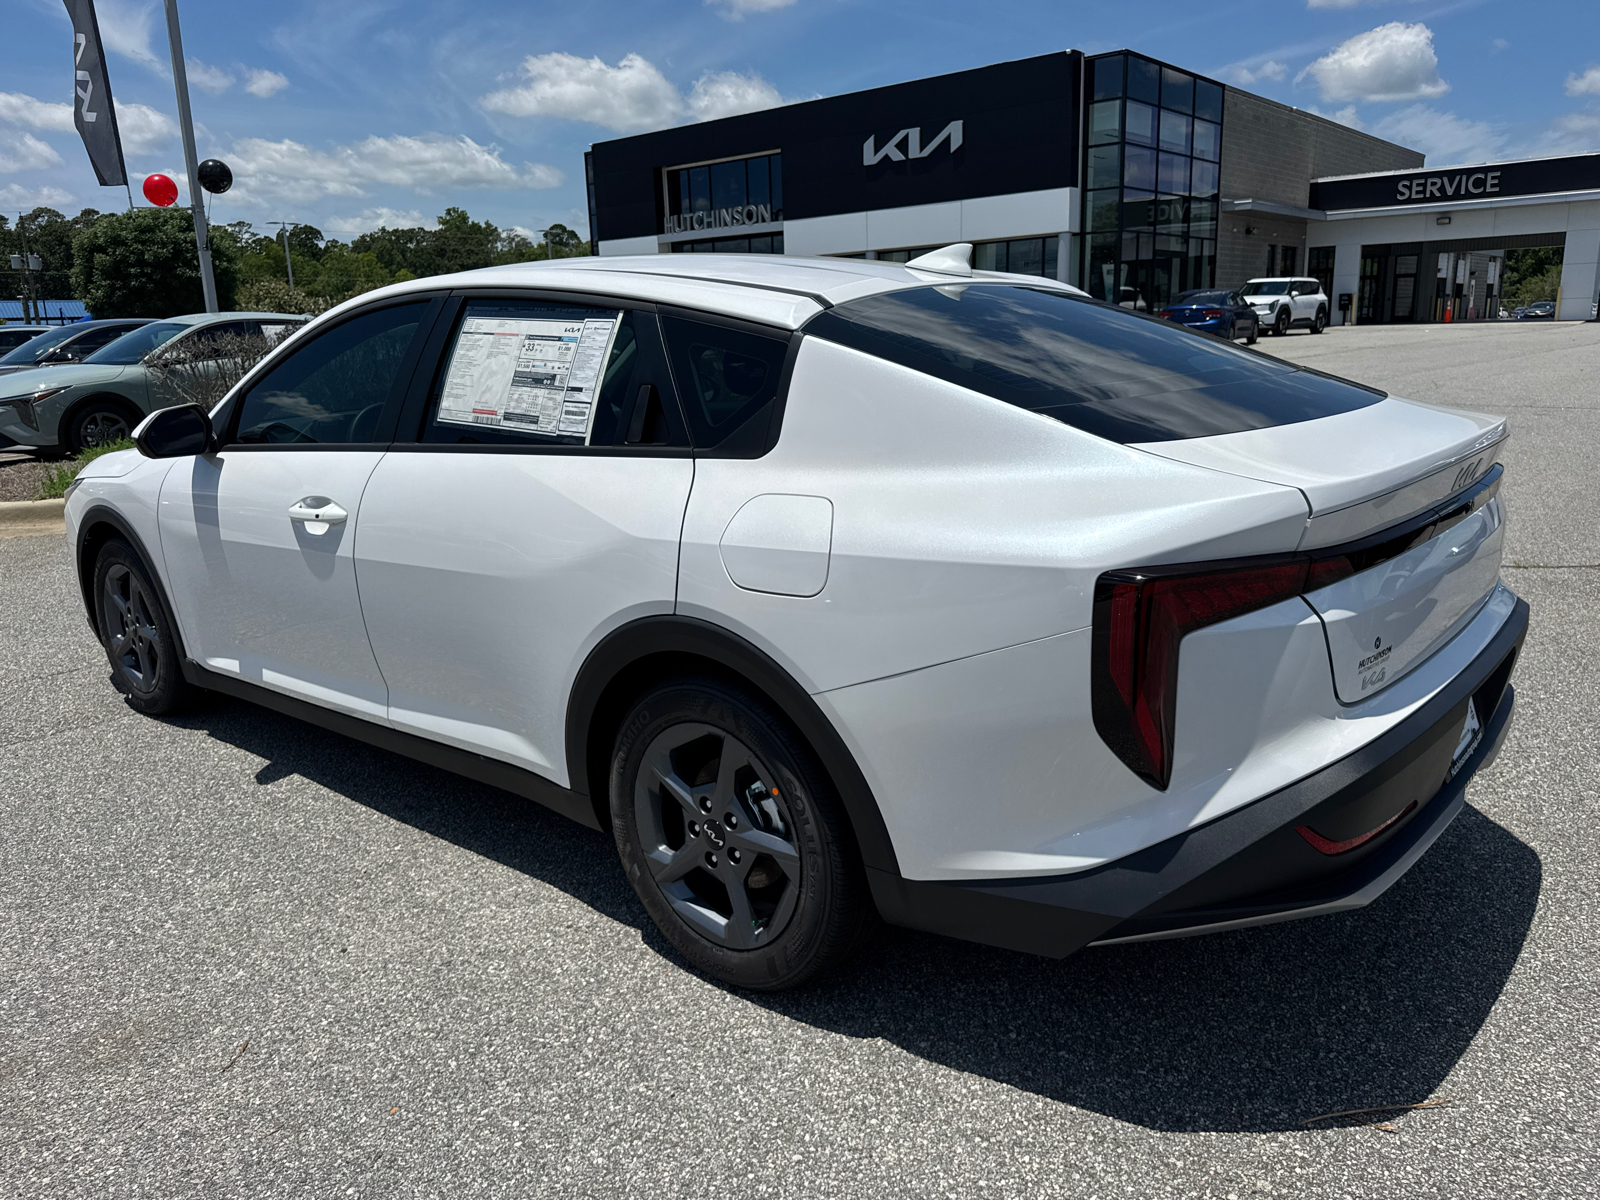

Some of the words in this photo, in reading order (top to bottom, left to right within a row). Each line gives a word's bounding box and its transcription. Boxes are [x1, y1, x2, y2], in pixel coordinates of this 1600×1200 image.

[863, 119, 963, 166] KIA
[1397, 171, 1501, 200] SERVICE
[664, 203, 772, 235] HUTCHINSON
[526, 343, 535, 352] 33
[1358, 645, 1392, 669] HUTCHINSON
[614, 709, 651, 776] KUMHO
